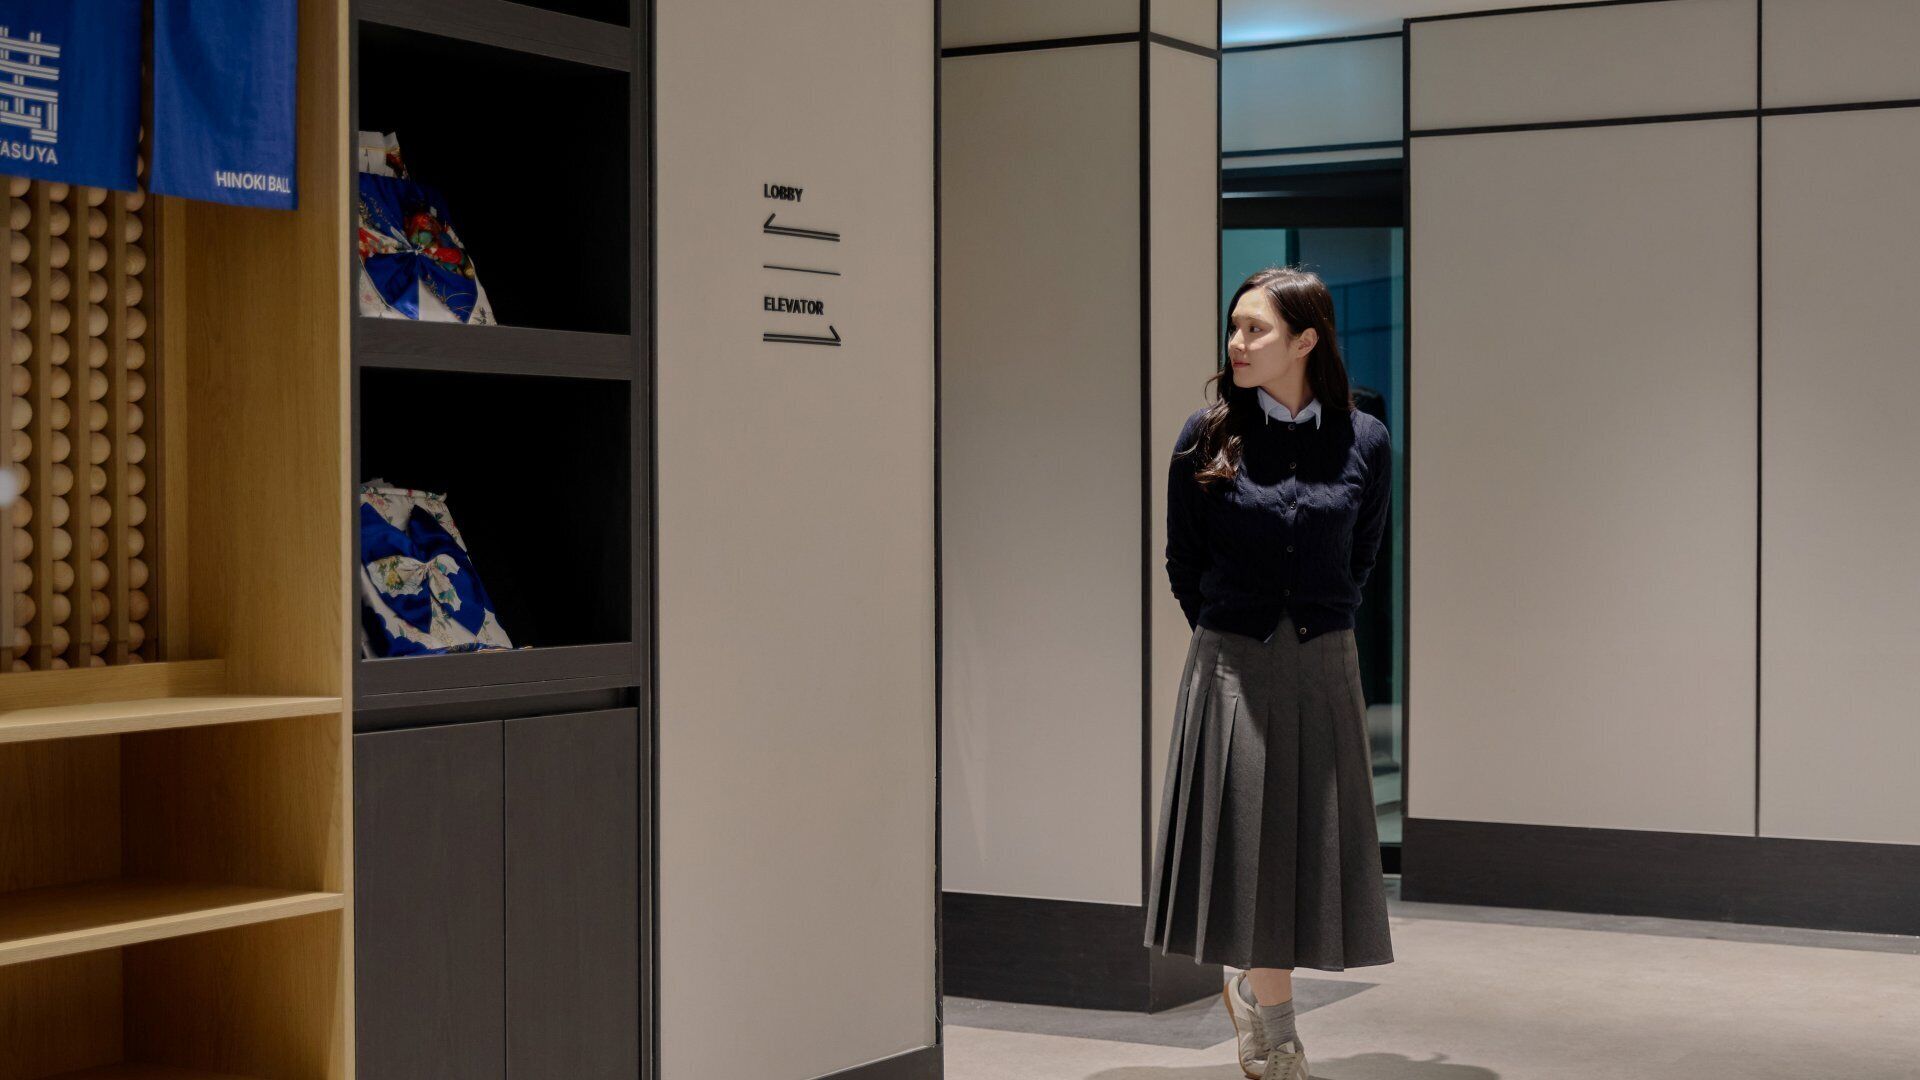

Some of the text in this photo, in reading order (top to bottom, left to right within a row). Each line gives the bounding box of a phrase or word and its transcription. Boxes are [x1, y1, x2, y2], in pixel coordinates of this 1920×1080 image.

[0, 140, 58, 165] ASUYA
[215, 170, 291, 193] HINOKI BALL
[763, 183, 803, 203] LOBBY
[763, 296, 824, 316] ELEVATOR
